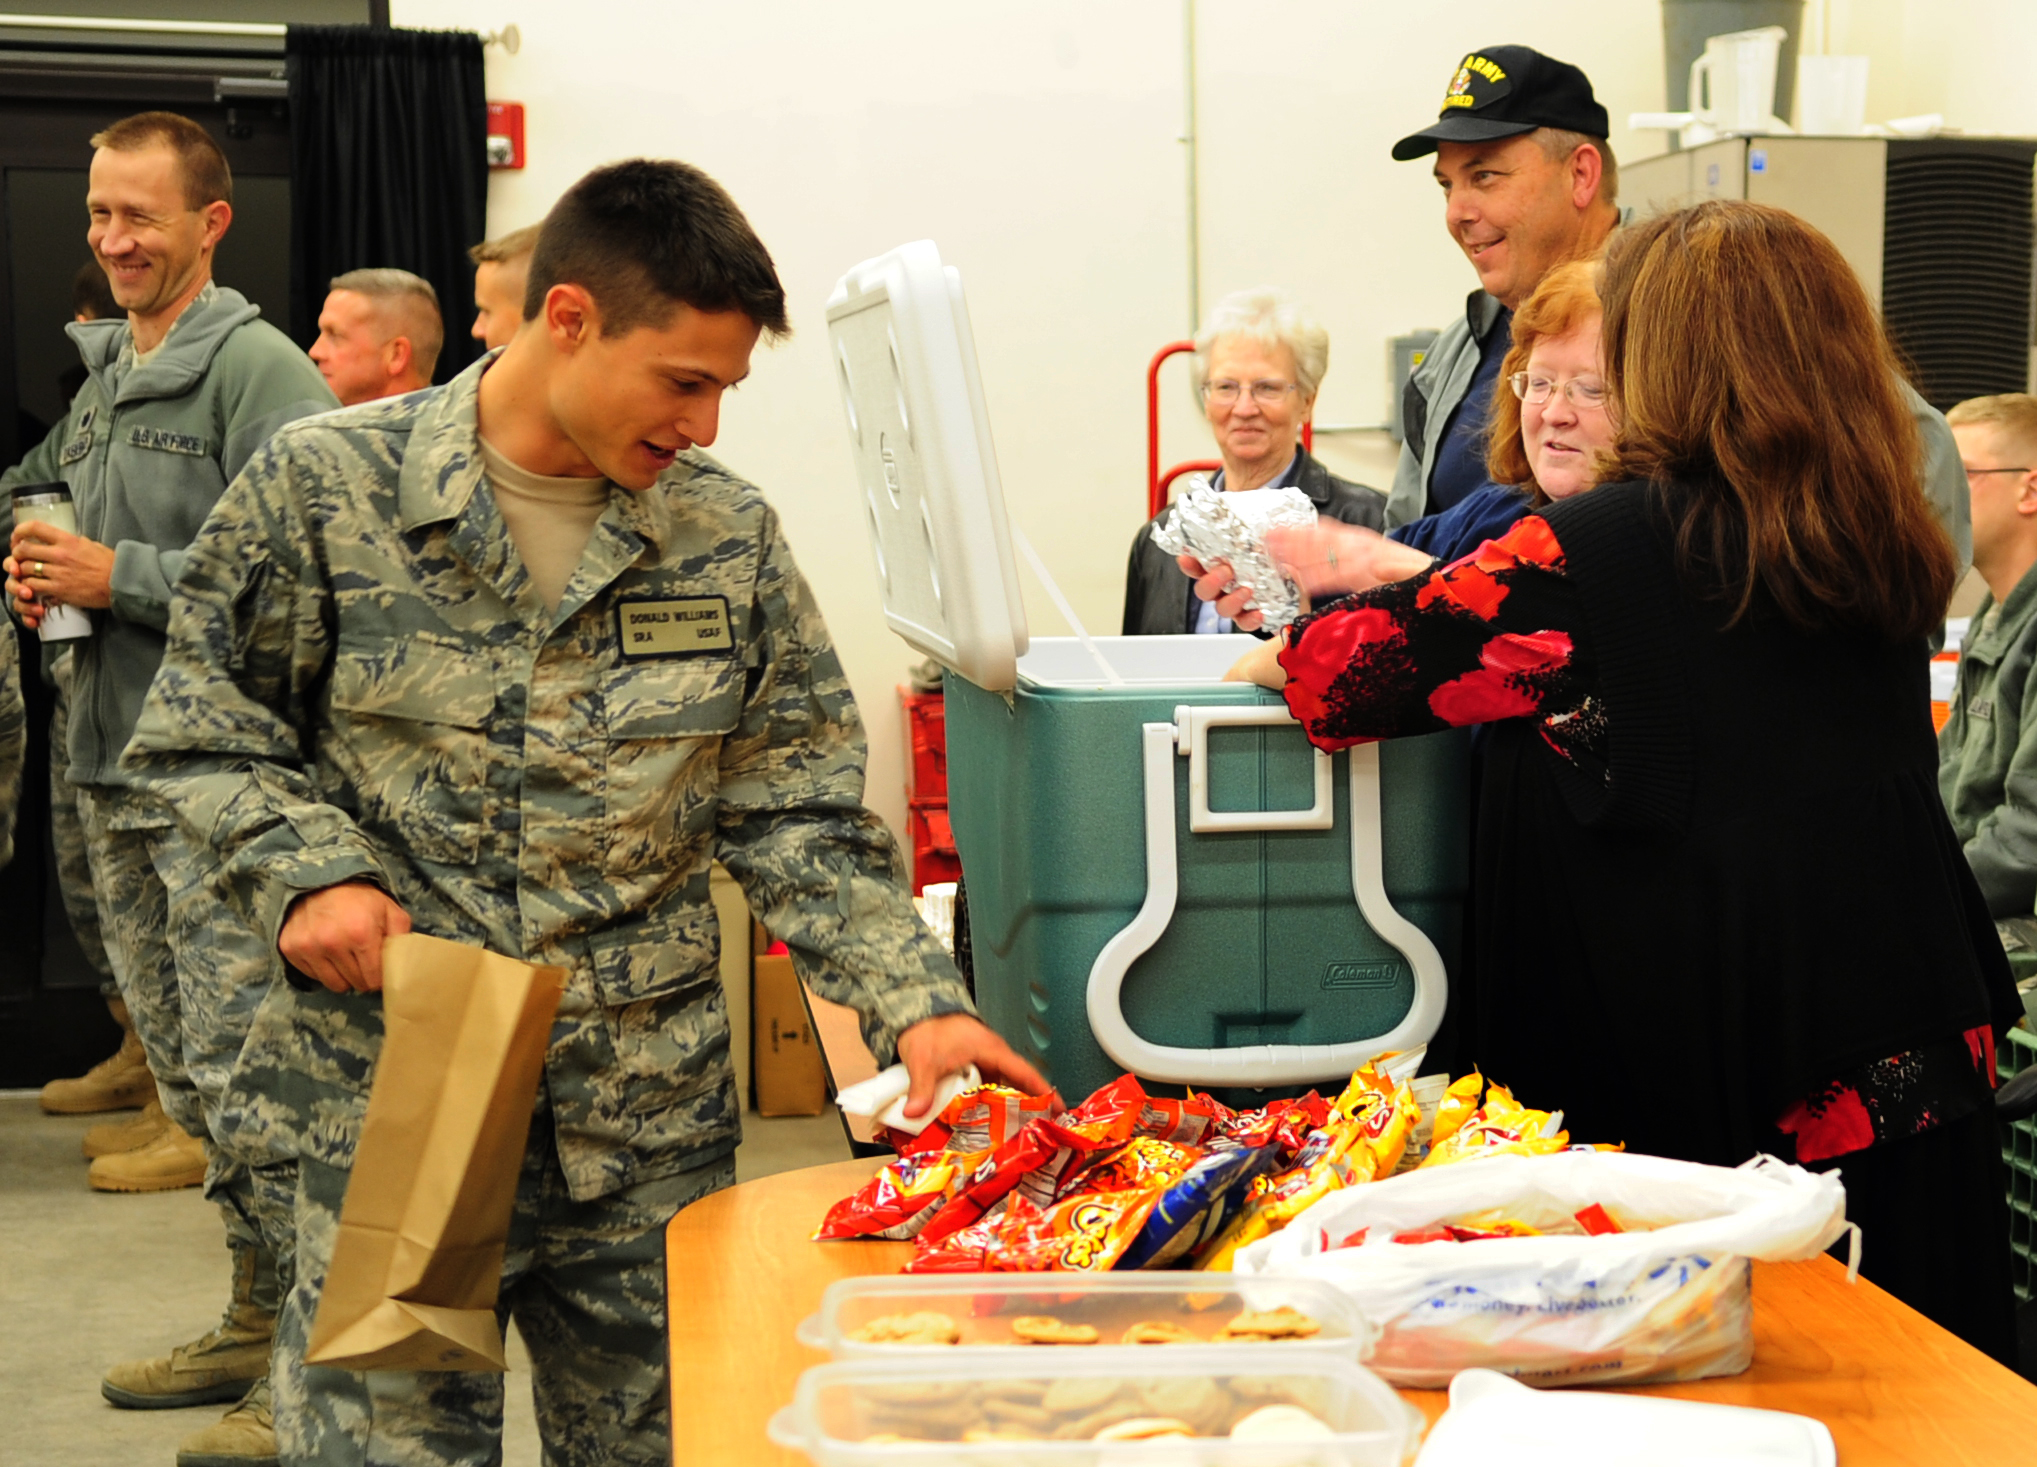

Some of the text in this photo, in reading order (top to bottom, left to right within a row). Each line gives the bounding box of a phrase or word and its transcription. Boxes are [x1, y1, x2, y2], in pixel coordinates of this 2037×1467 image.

[1463, 54, 1507, 83] ARMY
[153, 431, 168, 447] AIR
[170, 434, 201, 451] FORCE
[629, 609, 720, 625] DONALD WILLIAMS
[633, 627, 722, 643] SRA USAF
[1330, 964, 1381, 981] Coleman
